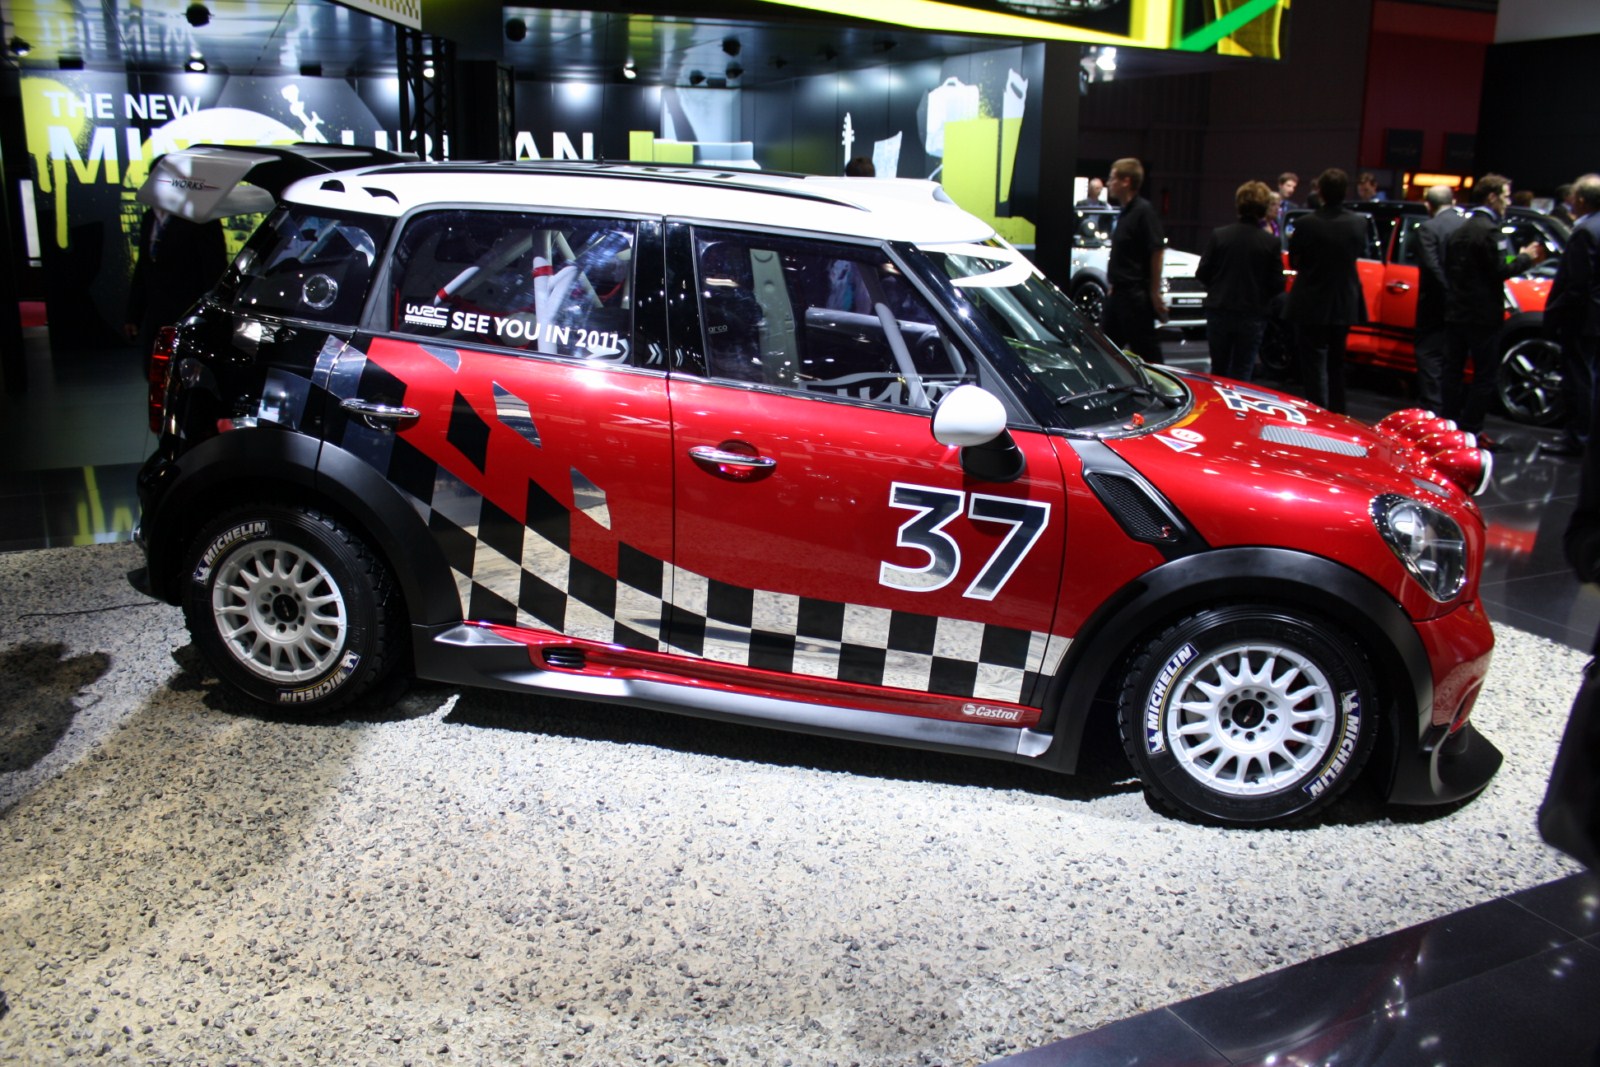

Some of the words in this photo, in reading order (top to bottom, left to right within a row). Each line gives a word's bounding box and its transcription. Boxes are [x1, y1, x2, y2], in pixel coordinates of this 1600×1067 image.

[44, 91, 115, 119] THE
[124, 93, 201, 120] NEW
[171, 179, 205, 191] WORKS
[405, 303, 450, 320] WRC
[451, 311, 490, 334] SEE
[494, 315, 541, 340] YOU
[545, 324, 570, 345] IN
[576, 328, 619, 351] 2011
[203, 520, 267, 568] MICHELIN
[879, 481, 1051, 601] 37
[279, 671, 347, 703] MICHELIN
[1147, 643, 1193, 731] MICHELIN
[975, 706, 1019, 721] Castrol
[1309, 713, 1361, 799] MICHELIN
